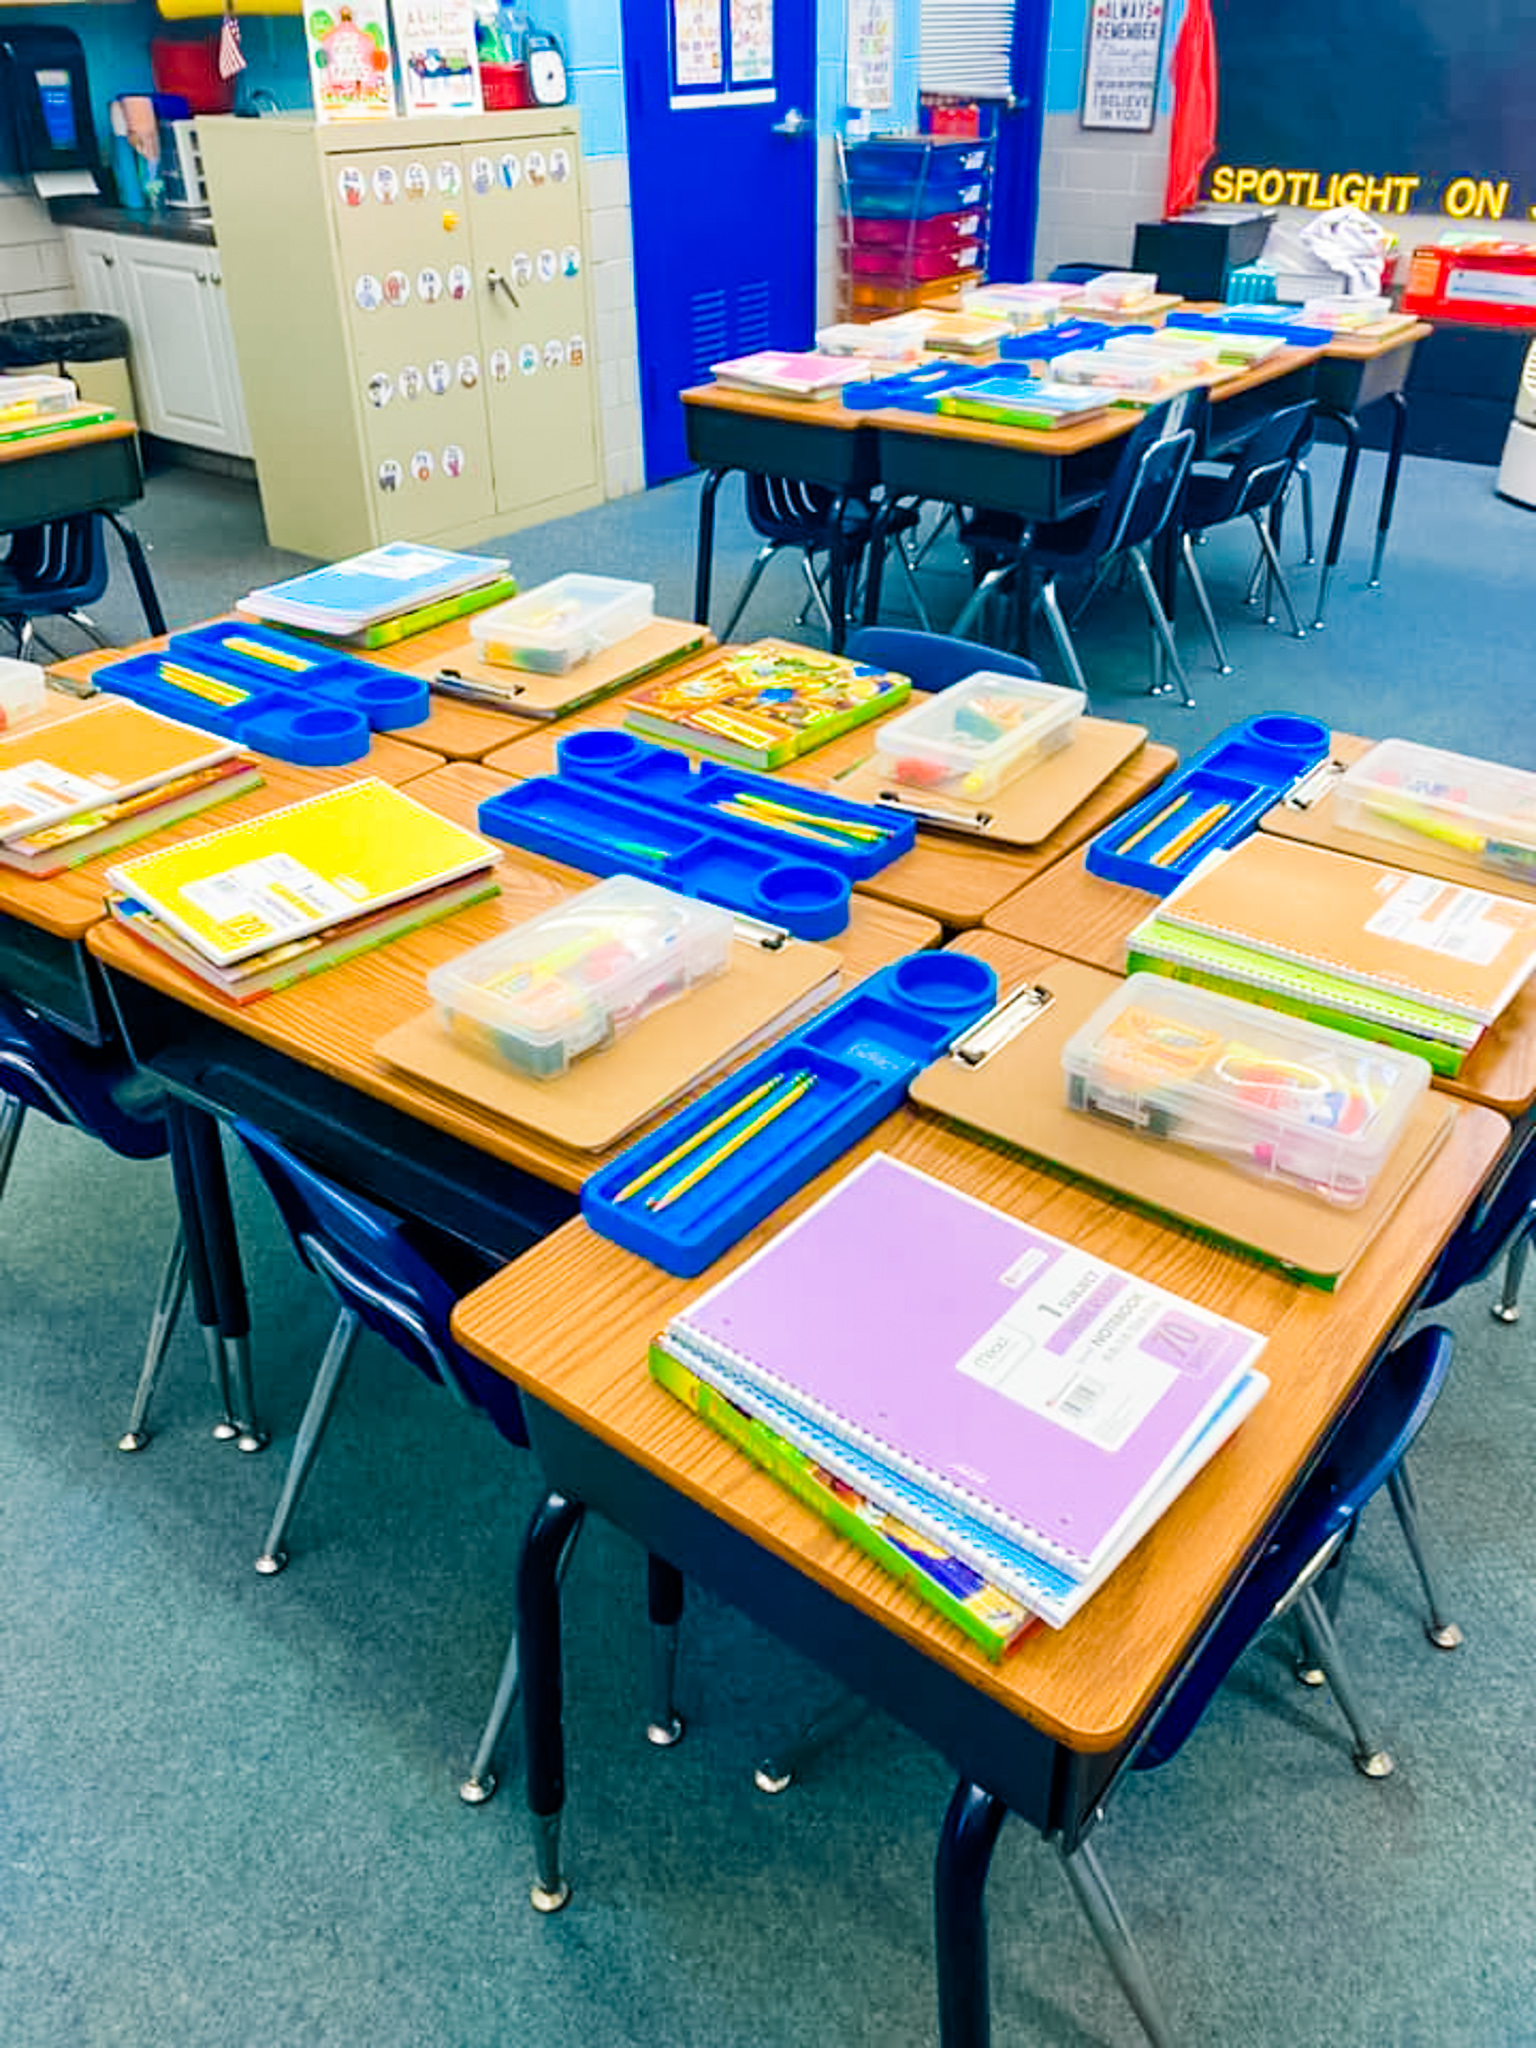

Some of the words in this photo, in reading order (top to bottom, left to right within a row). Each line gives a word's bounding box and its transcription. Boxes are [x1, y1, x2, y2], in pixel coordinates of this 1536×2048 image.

[1103, 0, 1153, 19] ALWAYS
[1096, 22, 1156, 39] REMEMBER
[1100, 93, 1150, 108] BELIEVE
[1115, 109, 1142, 121] YOU
[1211, 165, 1420, 214] SPOTLIGHT
[1445, 177, 1509, 219] ON
[1151, 1321, 1199, 1358] 70
